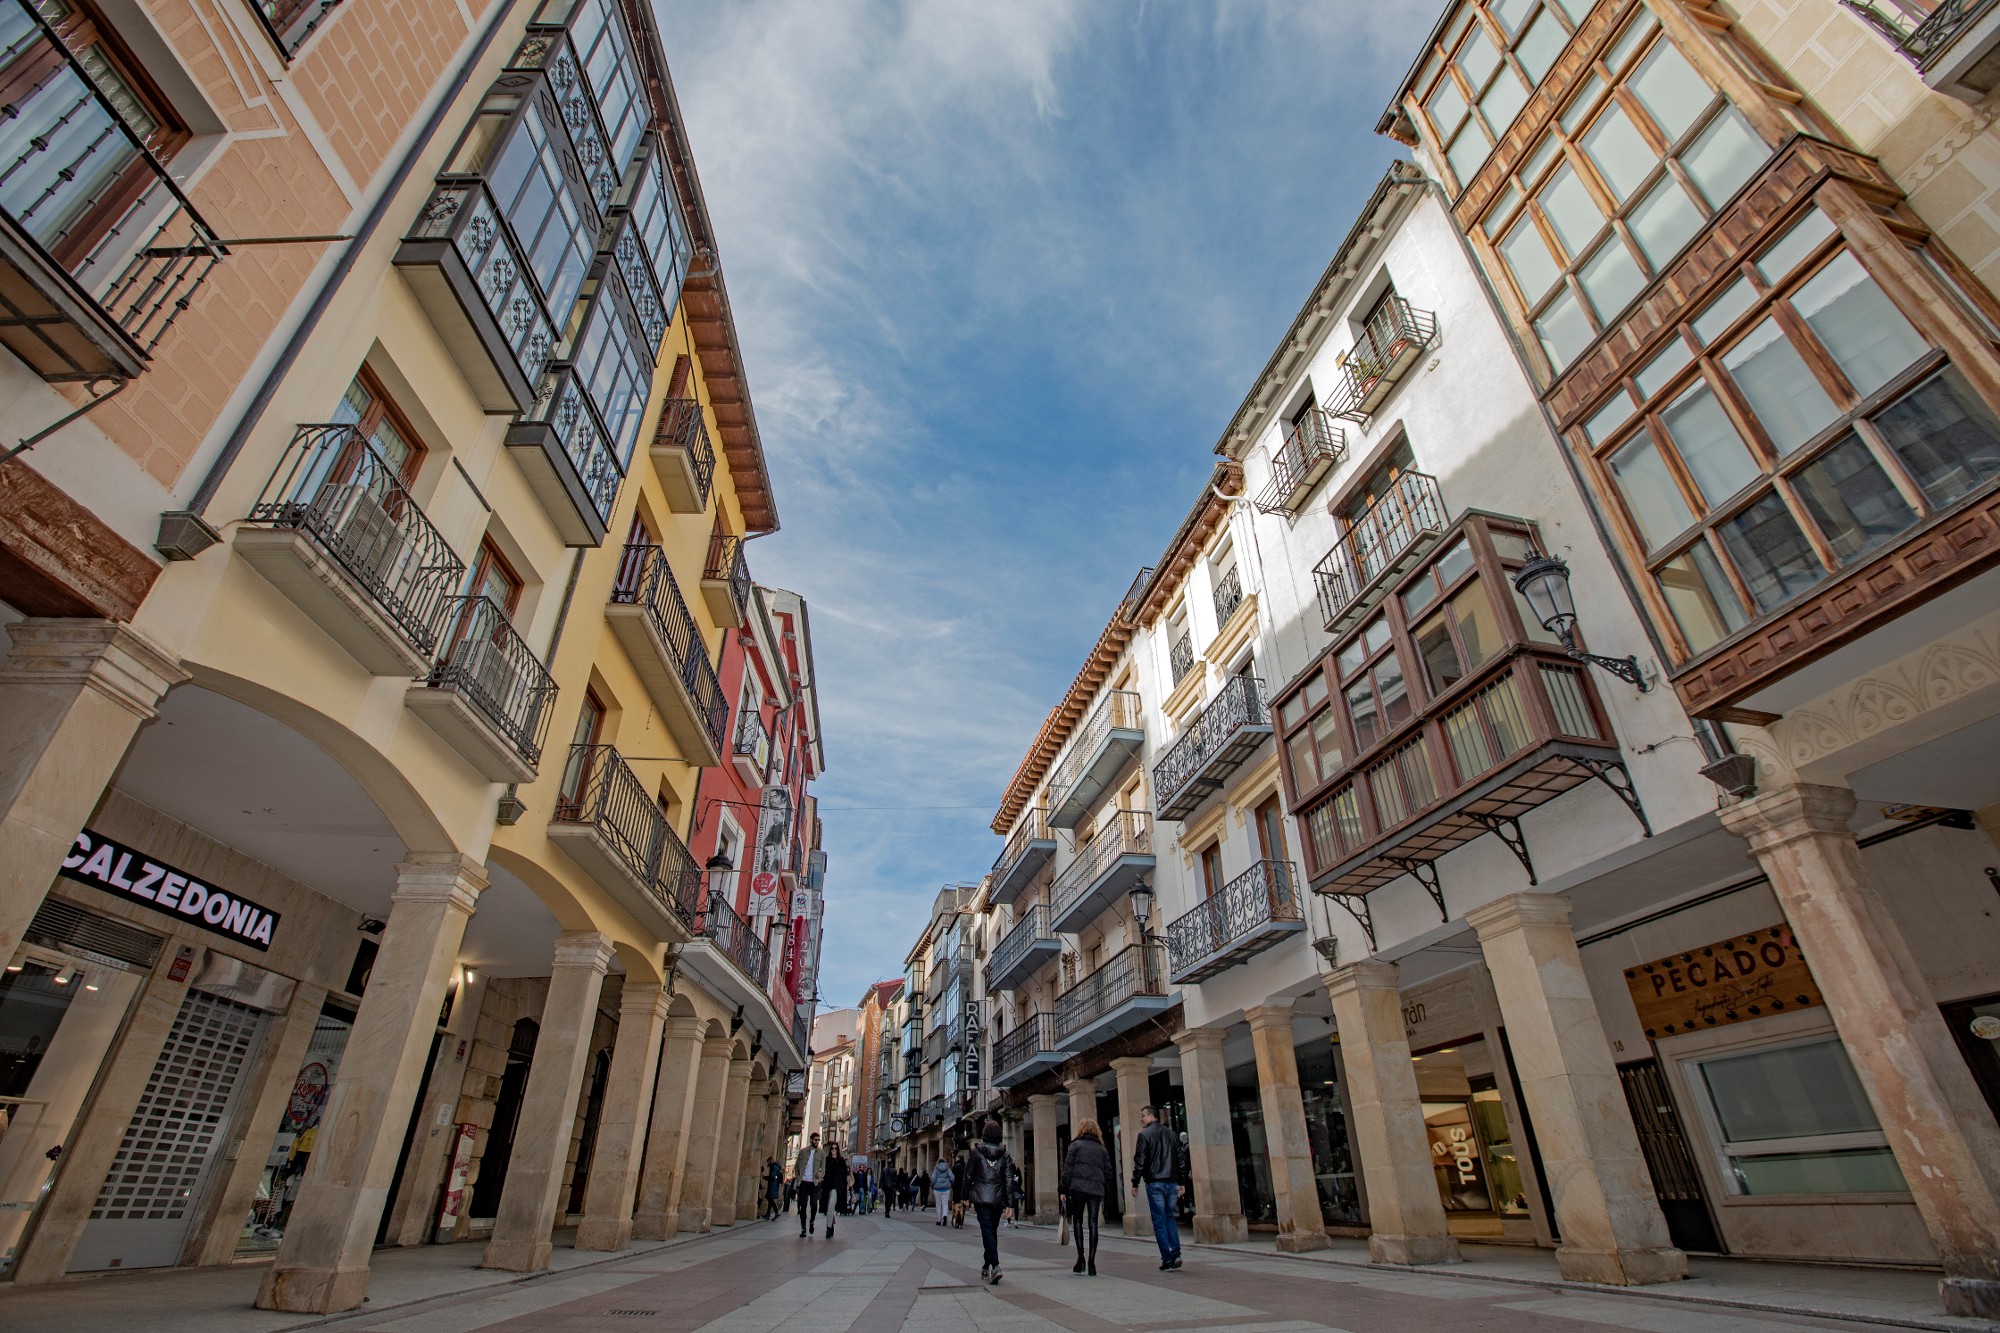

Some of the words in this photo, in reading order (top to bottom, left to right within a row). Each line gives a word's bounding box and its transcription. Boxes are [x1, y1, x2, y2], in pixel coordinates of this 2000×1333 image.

[62, 832, 273, 945] CALZEDONIA
[785, 922, 796, 973] 1848
[797, 941, 809, 1000] 2023
[1401, 1000, 1427, 1026] rán
[965, 1002, 979, 1089] RAFAEL
[1613, 1039, 1625, 1053] 18
[1450, 1127, 1477, 1185] TOUS
